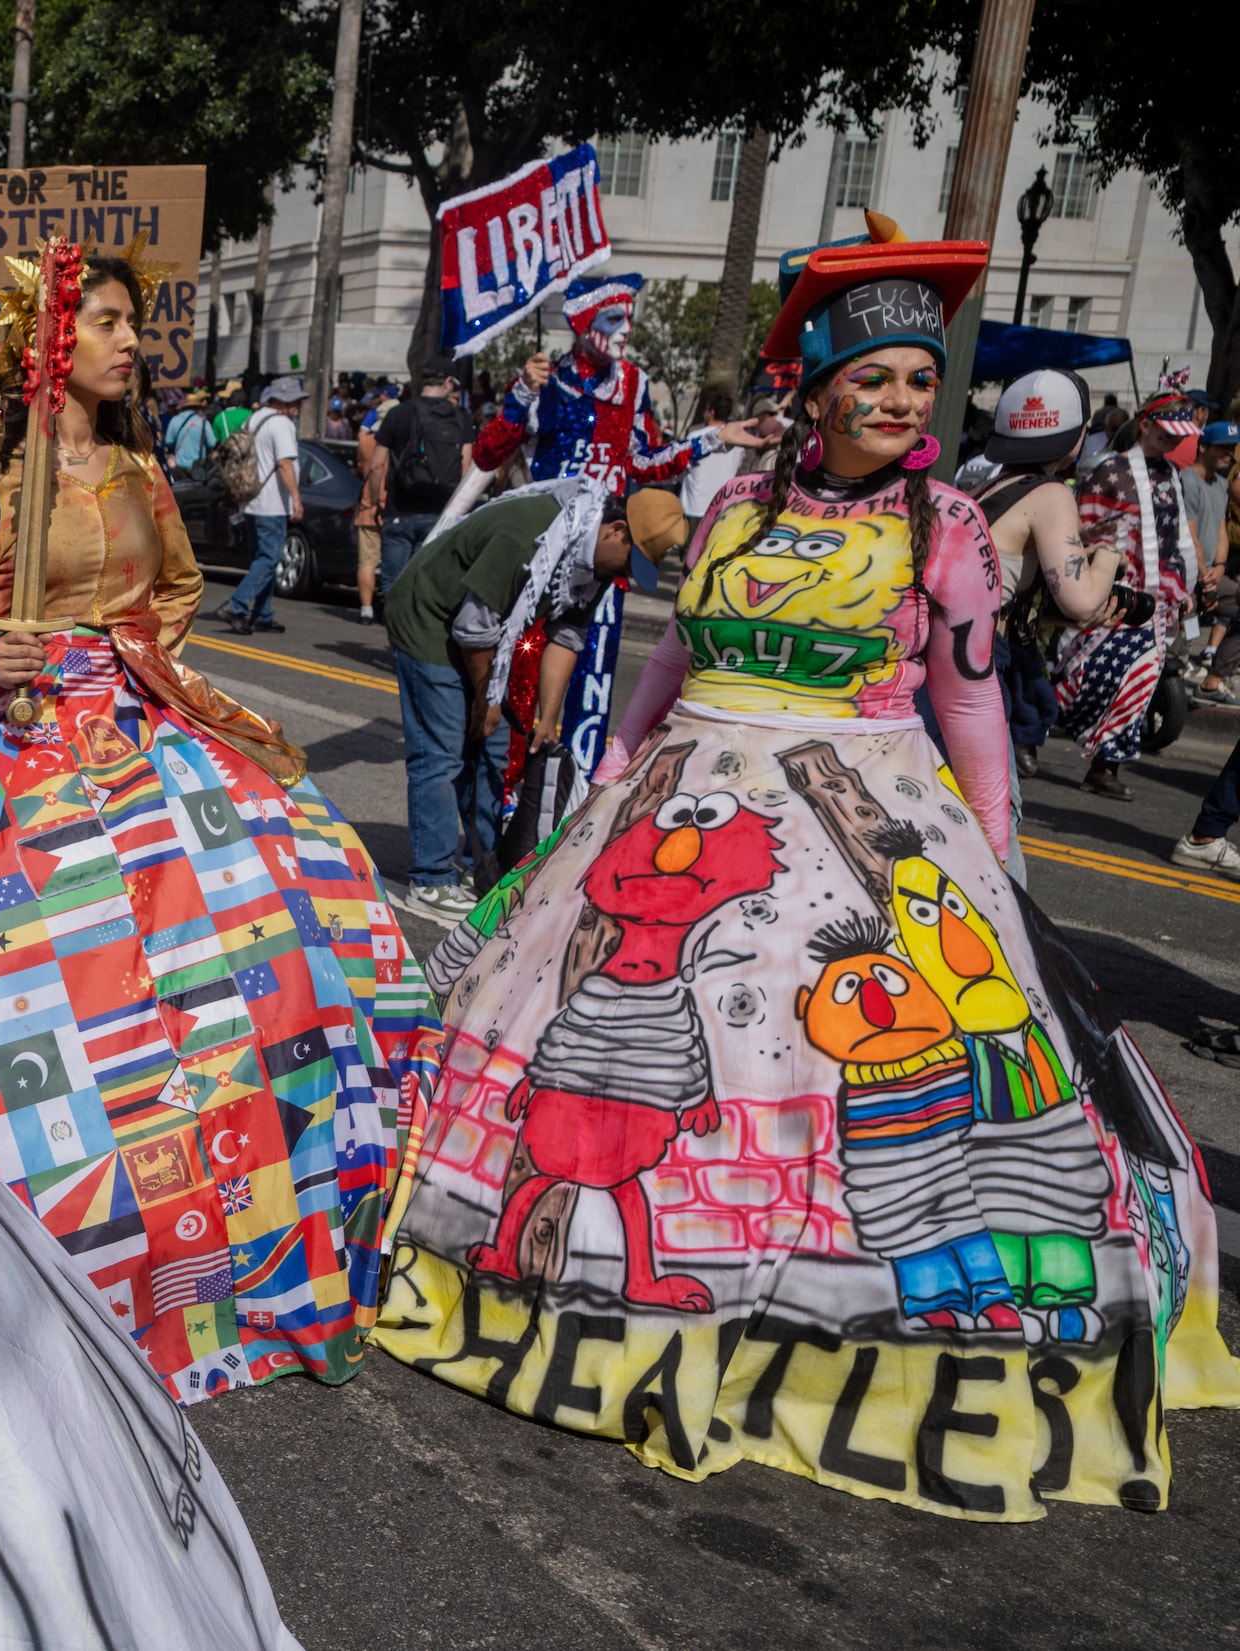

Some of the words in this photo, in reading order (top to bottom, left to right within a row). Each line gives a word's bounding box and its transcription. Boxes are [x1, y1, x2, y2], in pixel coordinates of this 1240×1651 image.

[68, 170, 128, 201] THE
[142, 280, 197, 326] AR,
[846, 283, 934, 313] FUCK
[849, 304, 941, 337] TRUMP!
[1009, 417, 1060, 430] WIENERS
[822, 502, 857, 519] BY
[932, 495, 999, 592] LETTERS
